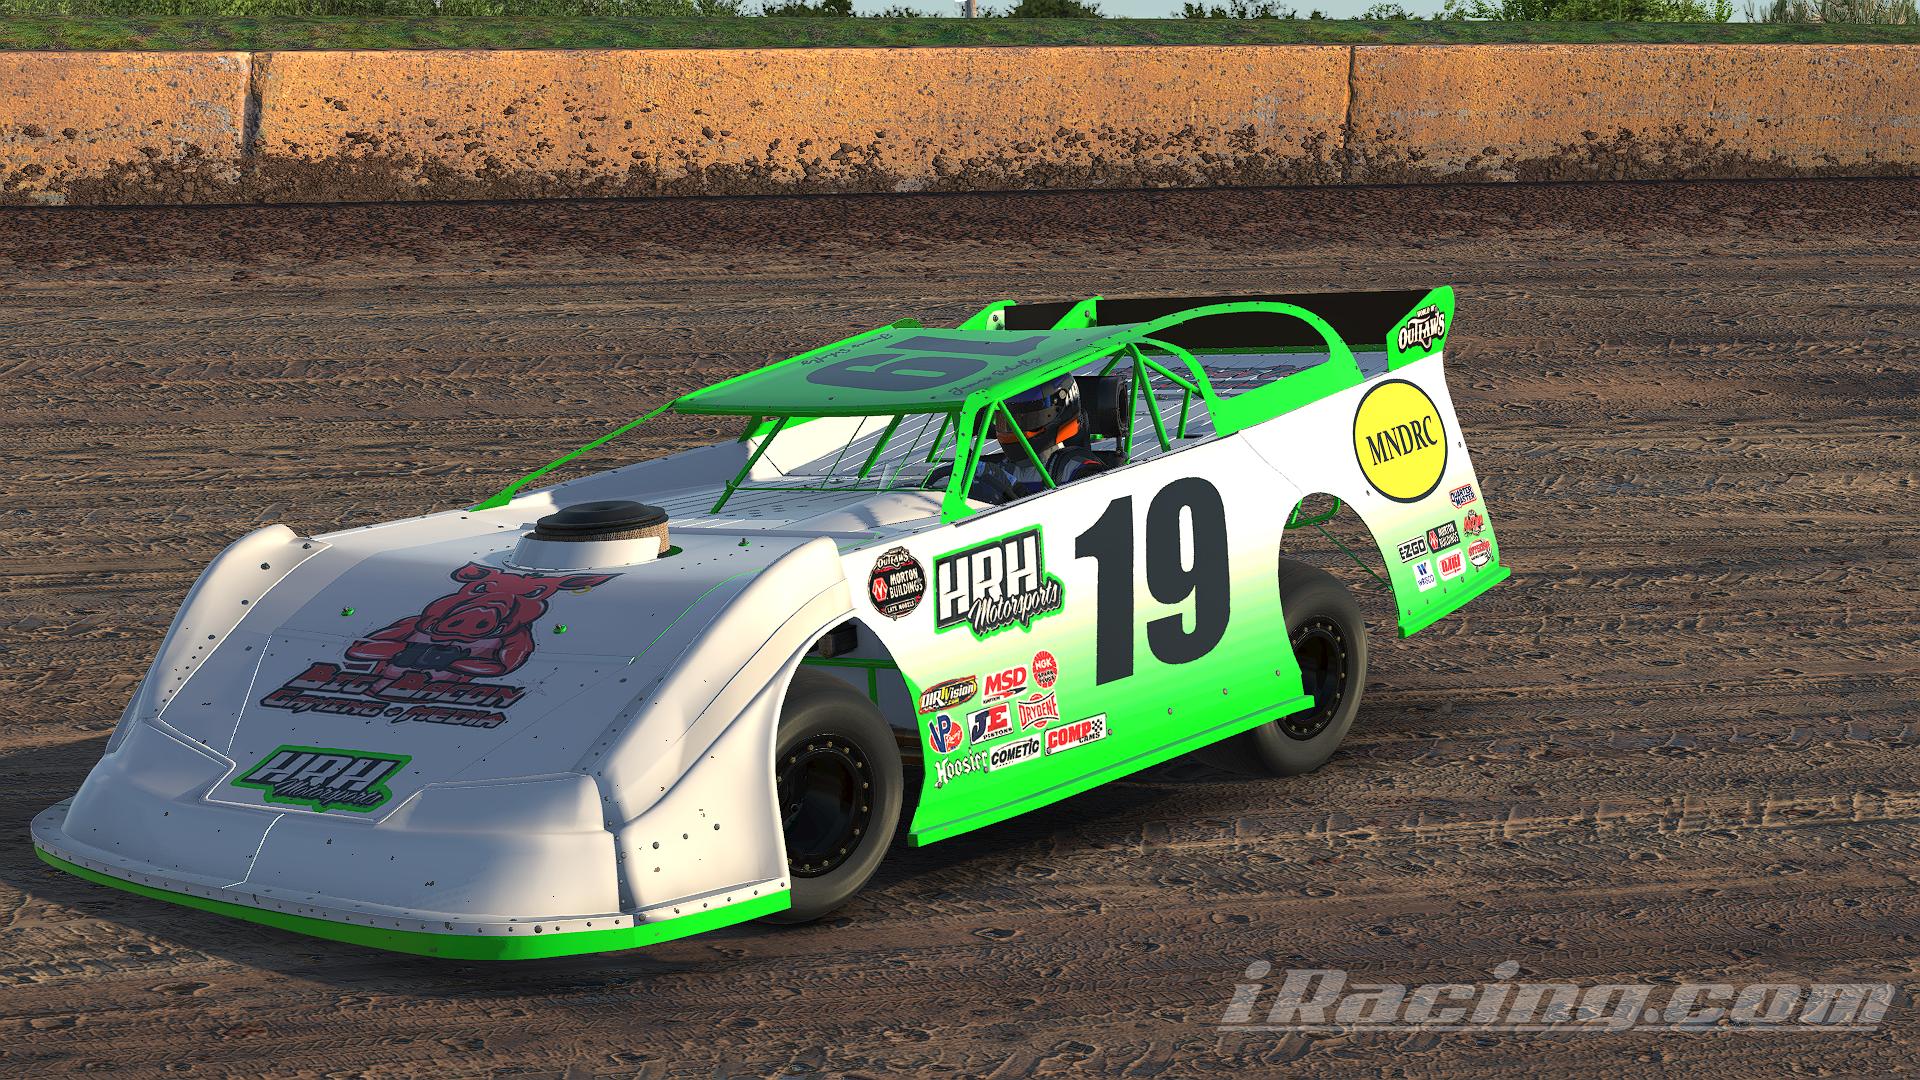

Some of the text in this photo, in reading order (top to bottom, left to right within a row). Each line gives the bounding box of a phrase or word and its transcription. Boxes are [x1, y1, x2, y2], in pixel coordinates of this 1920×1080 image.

[1366, 415, 1438, 466] MNDRC
[889, 580, 923, 599] BUILDINGS
[890, 568, 918, 585] MORTON
[939, 535, 1037, 620] HRH
[1075, 477, 1230, 686] 19
[968, 581, 1058, 630] Motorsports
[984, 667, 1027, 696] MSD
[971, 705, 1008, 742] JE
[1018, 694, 1059, 727] DRYDENE
[983, 727, 1013, 740] PISTONS
[1048, 721, 1091, 748] COMP
[1079, 732, 1100, 743] CAMS
[243, 751, 400, 792] HRH
